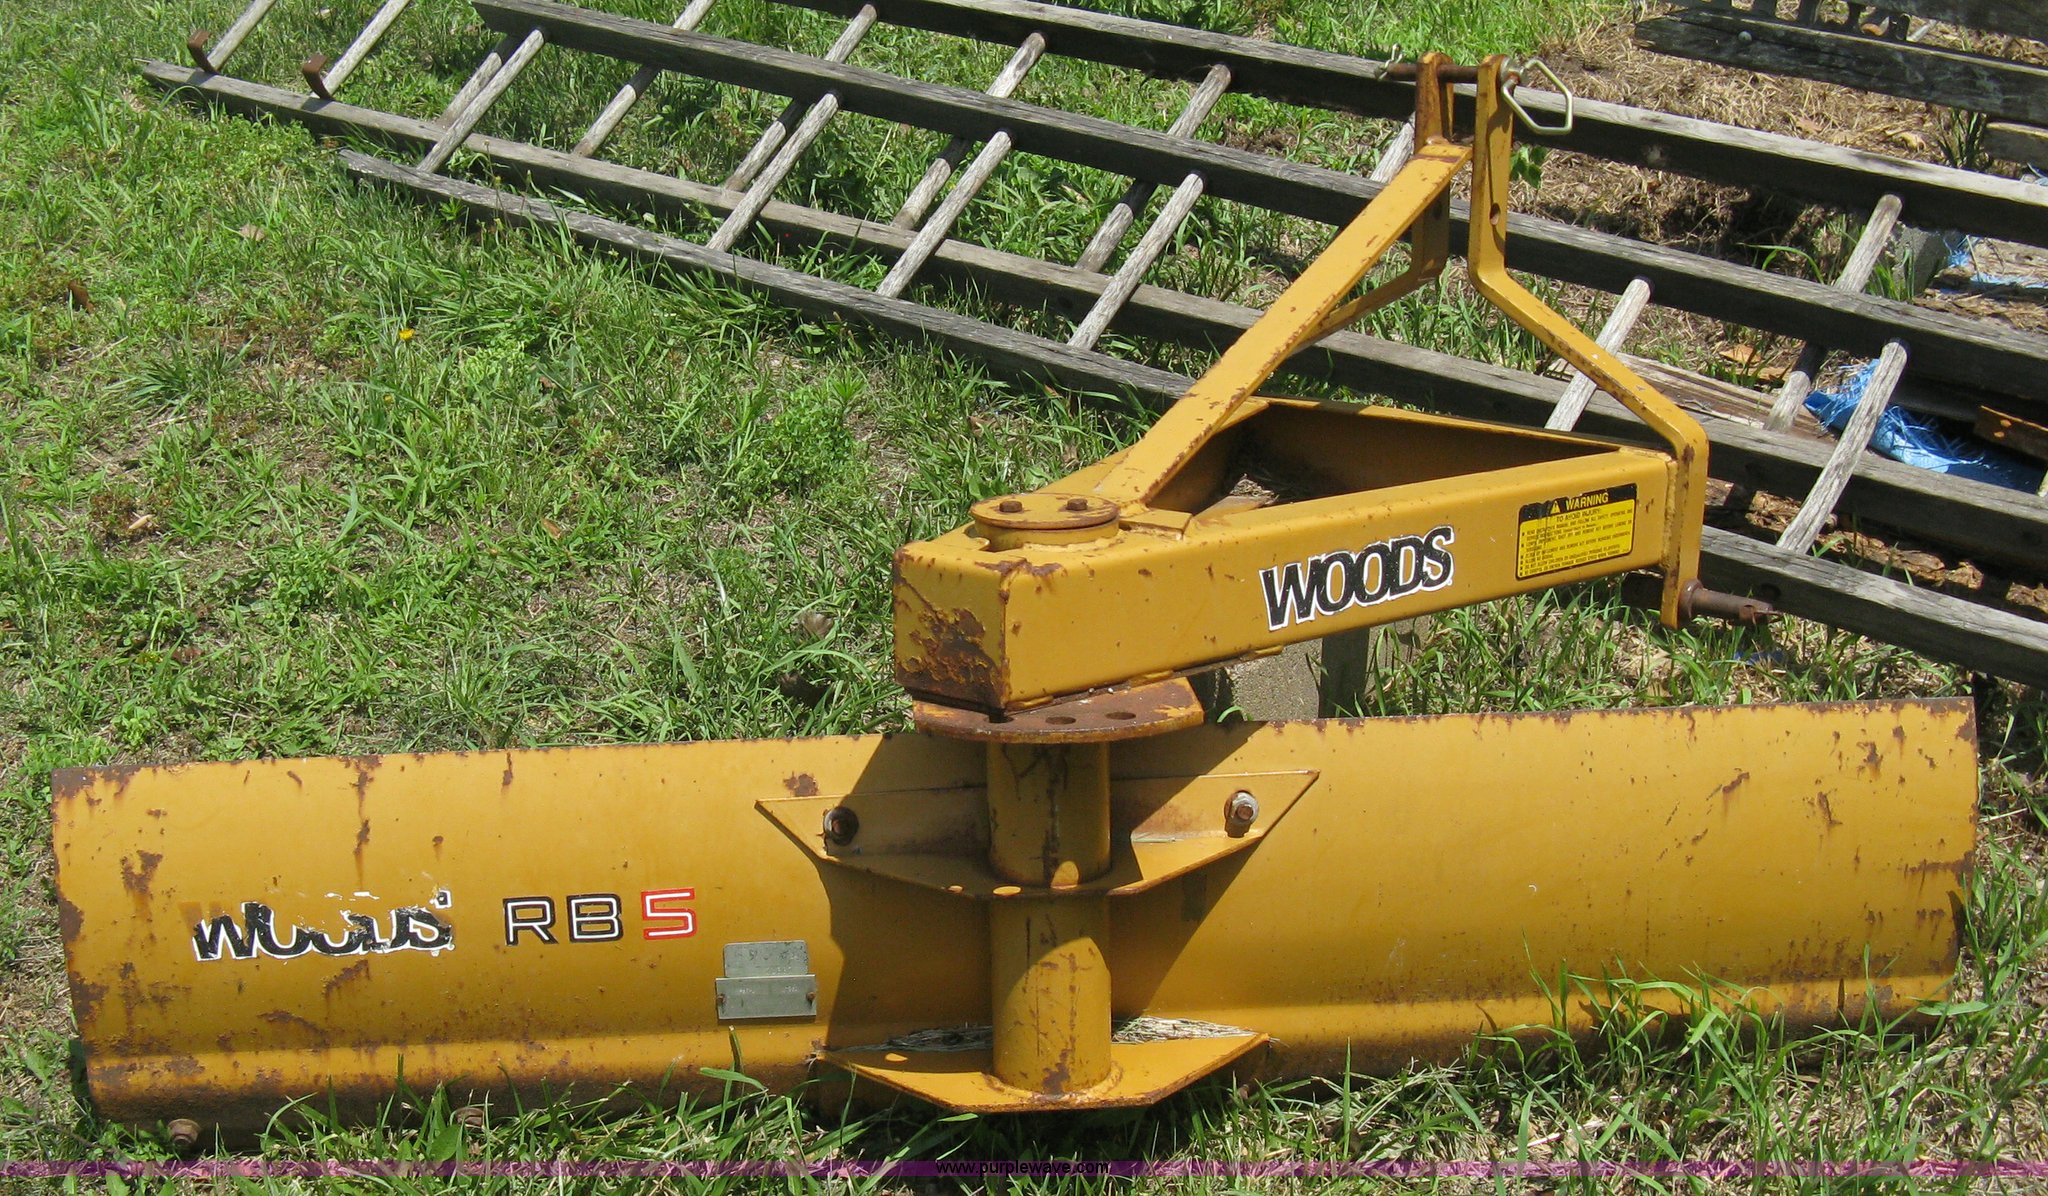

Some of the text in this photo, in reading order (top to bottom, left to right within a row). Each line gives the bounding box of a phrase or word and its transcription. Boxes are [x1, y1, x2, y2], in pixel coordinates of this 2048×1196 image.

[1566, 492, 1609, 511] WARNING
[1556, 515, 1564, 523] TO
[1260, 526, 1454, 631] WOODS
